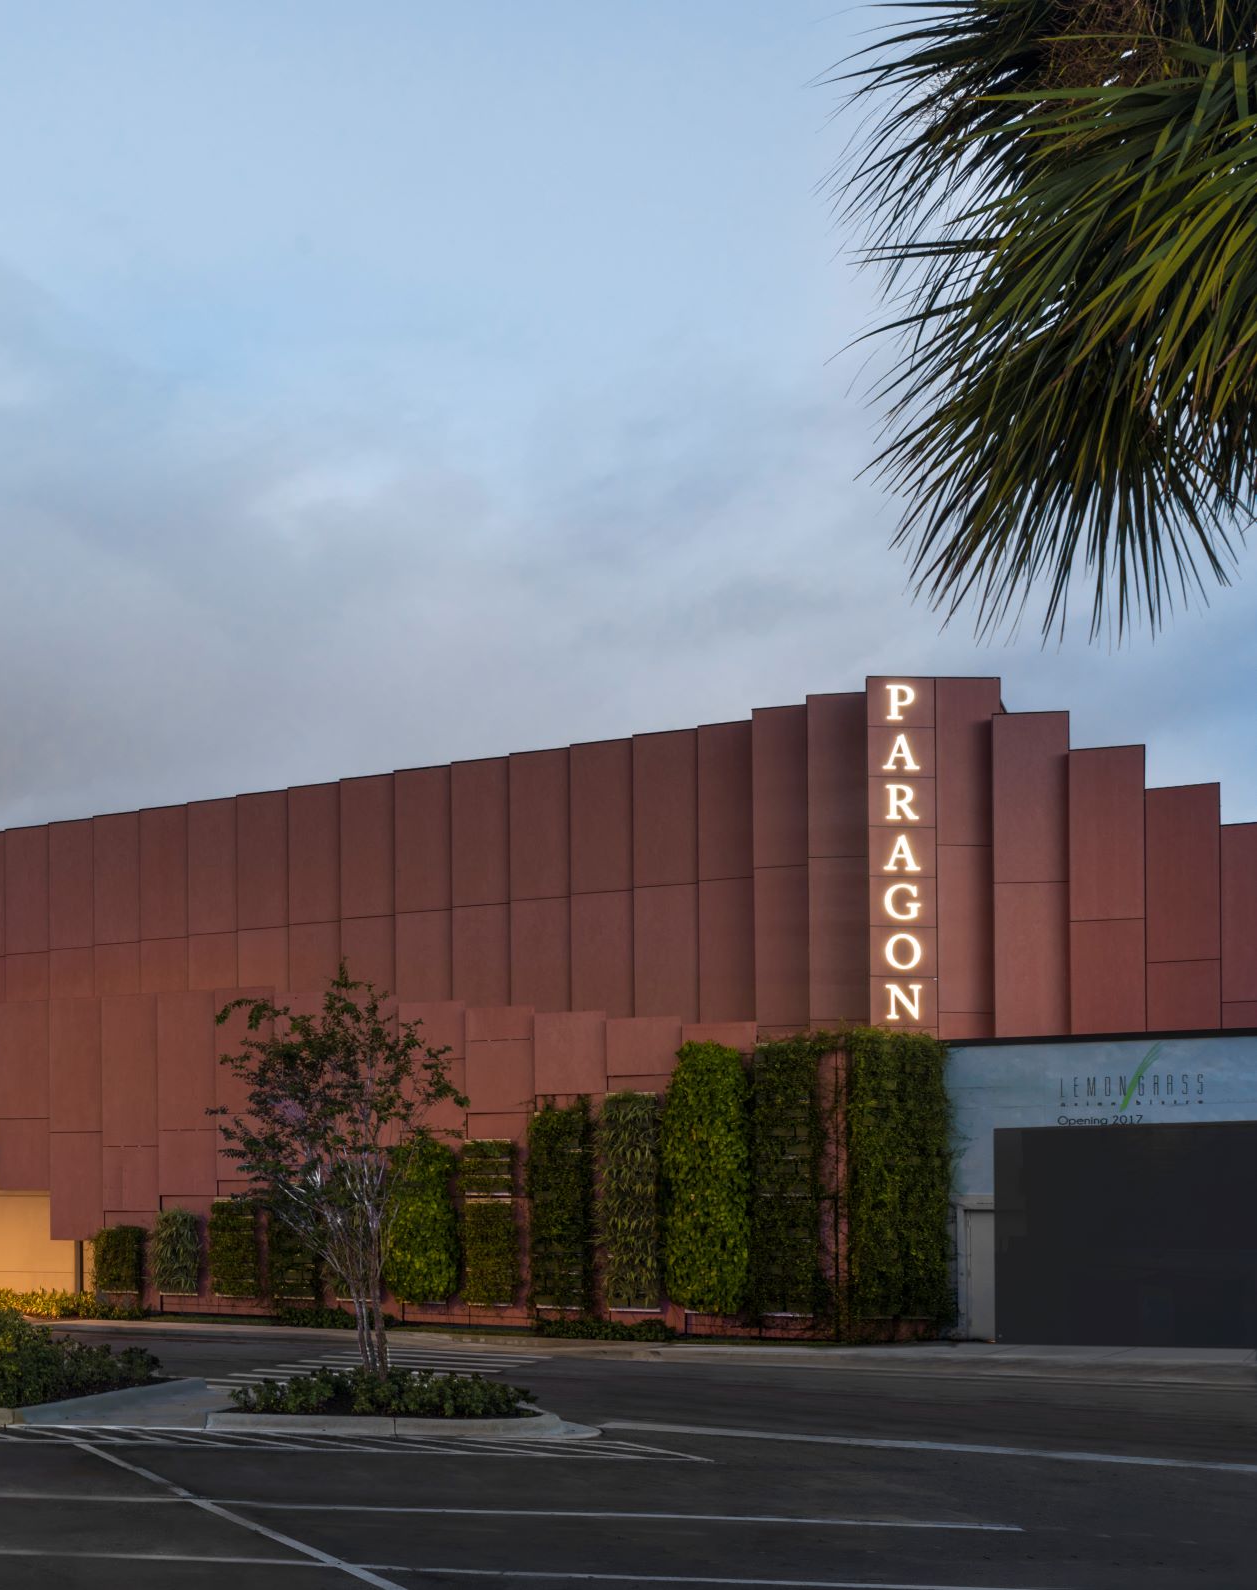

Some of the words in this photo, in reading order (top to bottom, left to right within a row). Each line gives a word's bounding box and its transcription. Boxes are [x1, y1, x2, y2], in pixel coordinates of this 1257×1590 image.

[882, 684, 923, 1021] PARAGON
[1057, 1115, 1108, 1126] Opening
[1112, 1114, 1144, 1126] 2017
